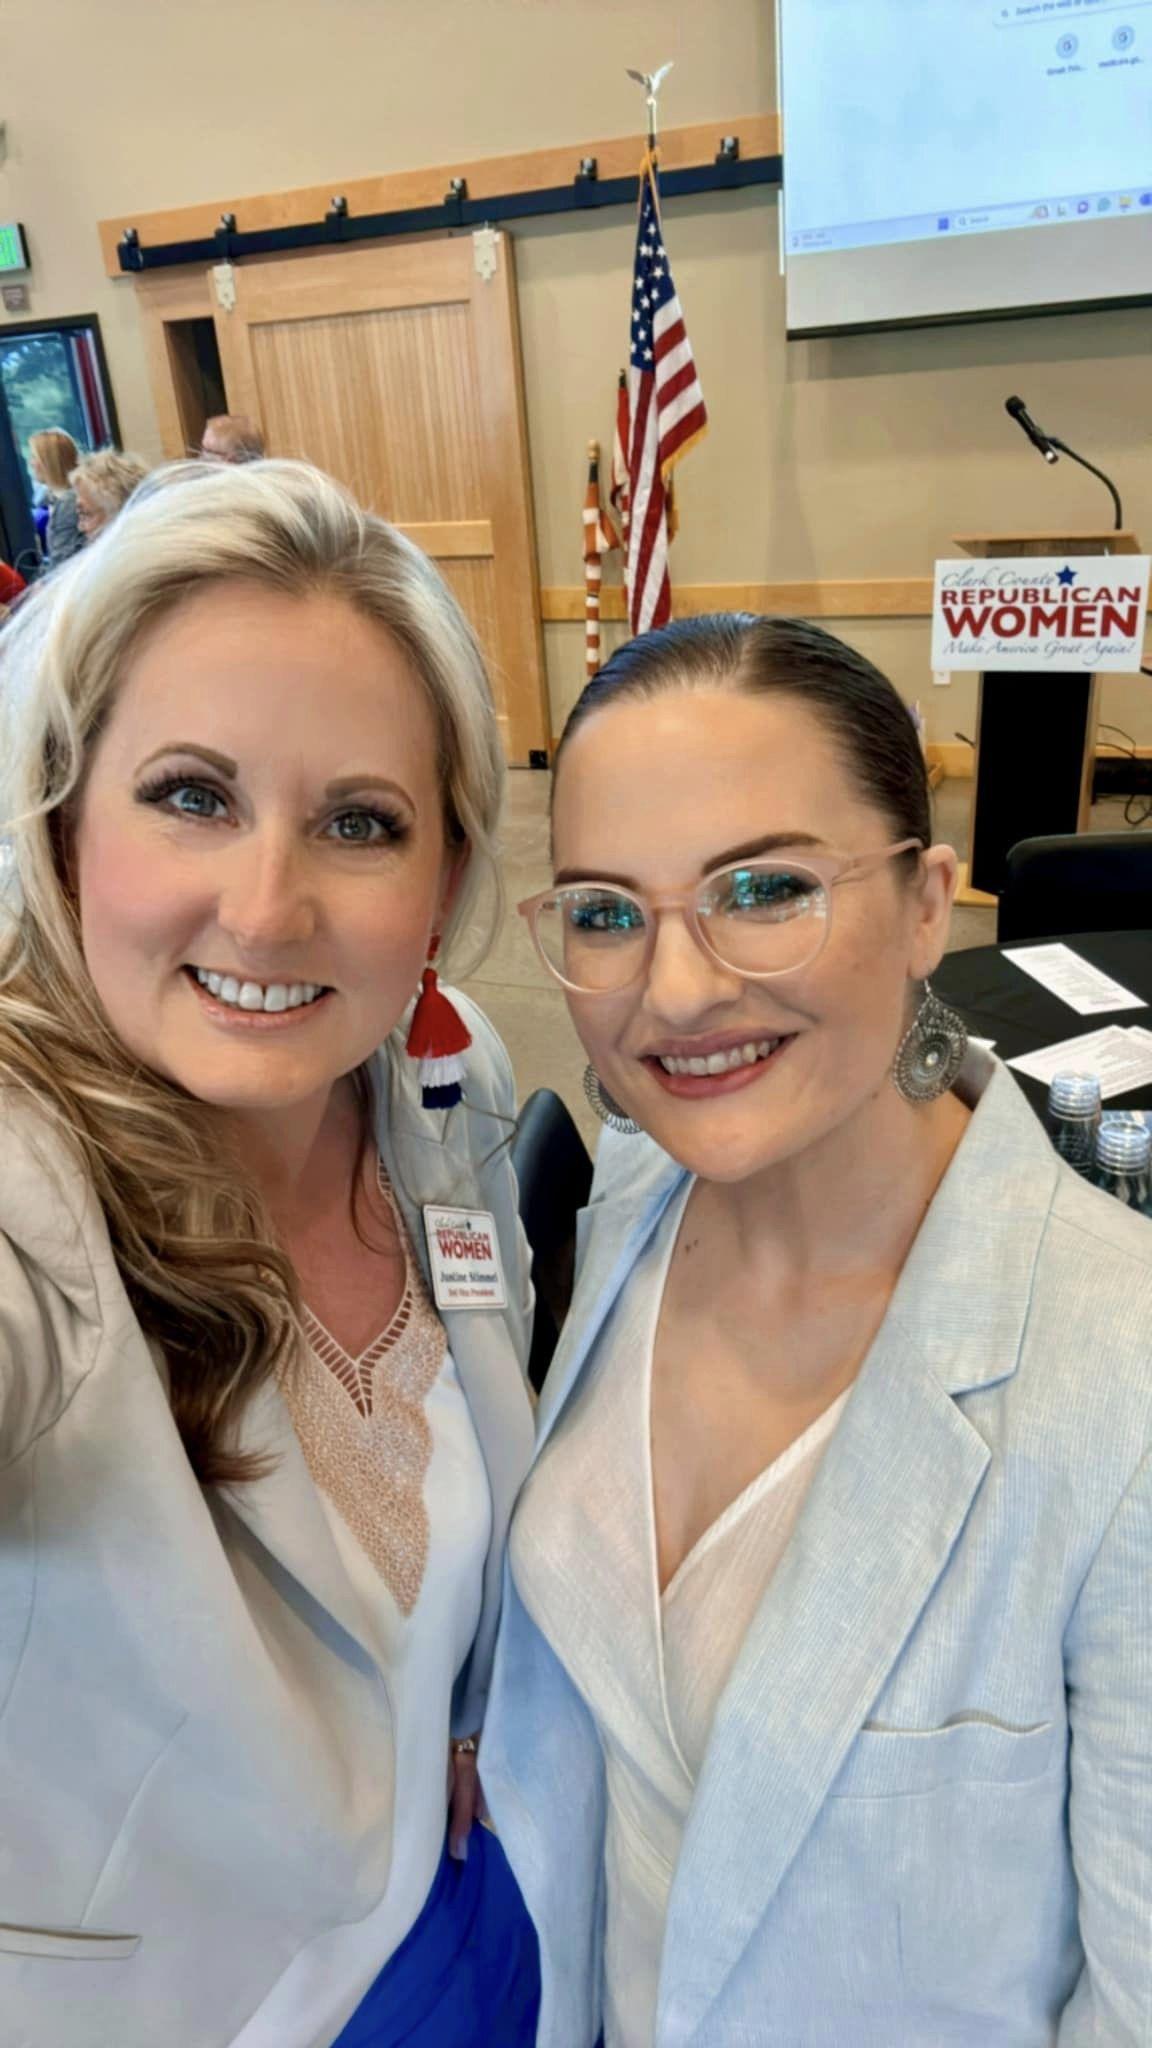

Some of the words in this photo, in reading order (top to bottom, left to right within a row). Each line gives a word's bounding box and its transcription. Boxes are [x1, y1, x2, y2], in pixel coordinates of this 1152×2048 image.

[942, 567, 1000, 586] Clark
[998, 571, 1056, 587] County
[941, 587, 1141, 604] REPUBLICAN
[942, 606, 1138, 638] WOMEN
[943, 640, 983, 654] Make
[984, 641, 1039, 655] America
[1044, 641, 1082, 660] Great
[436, 1229, 490, 1241] REPUBLICAN
[439, 1241, 492, 1260] WOMEN
